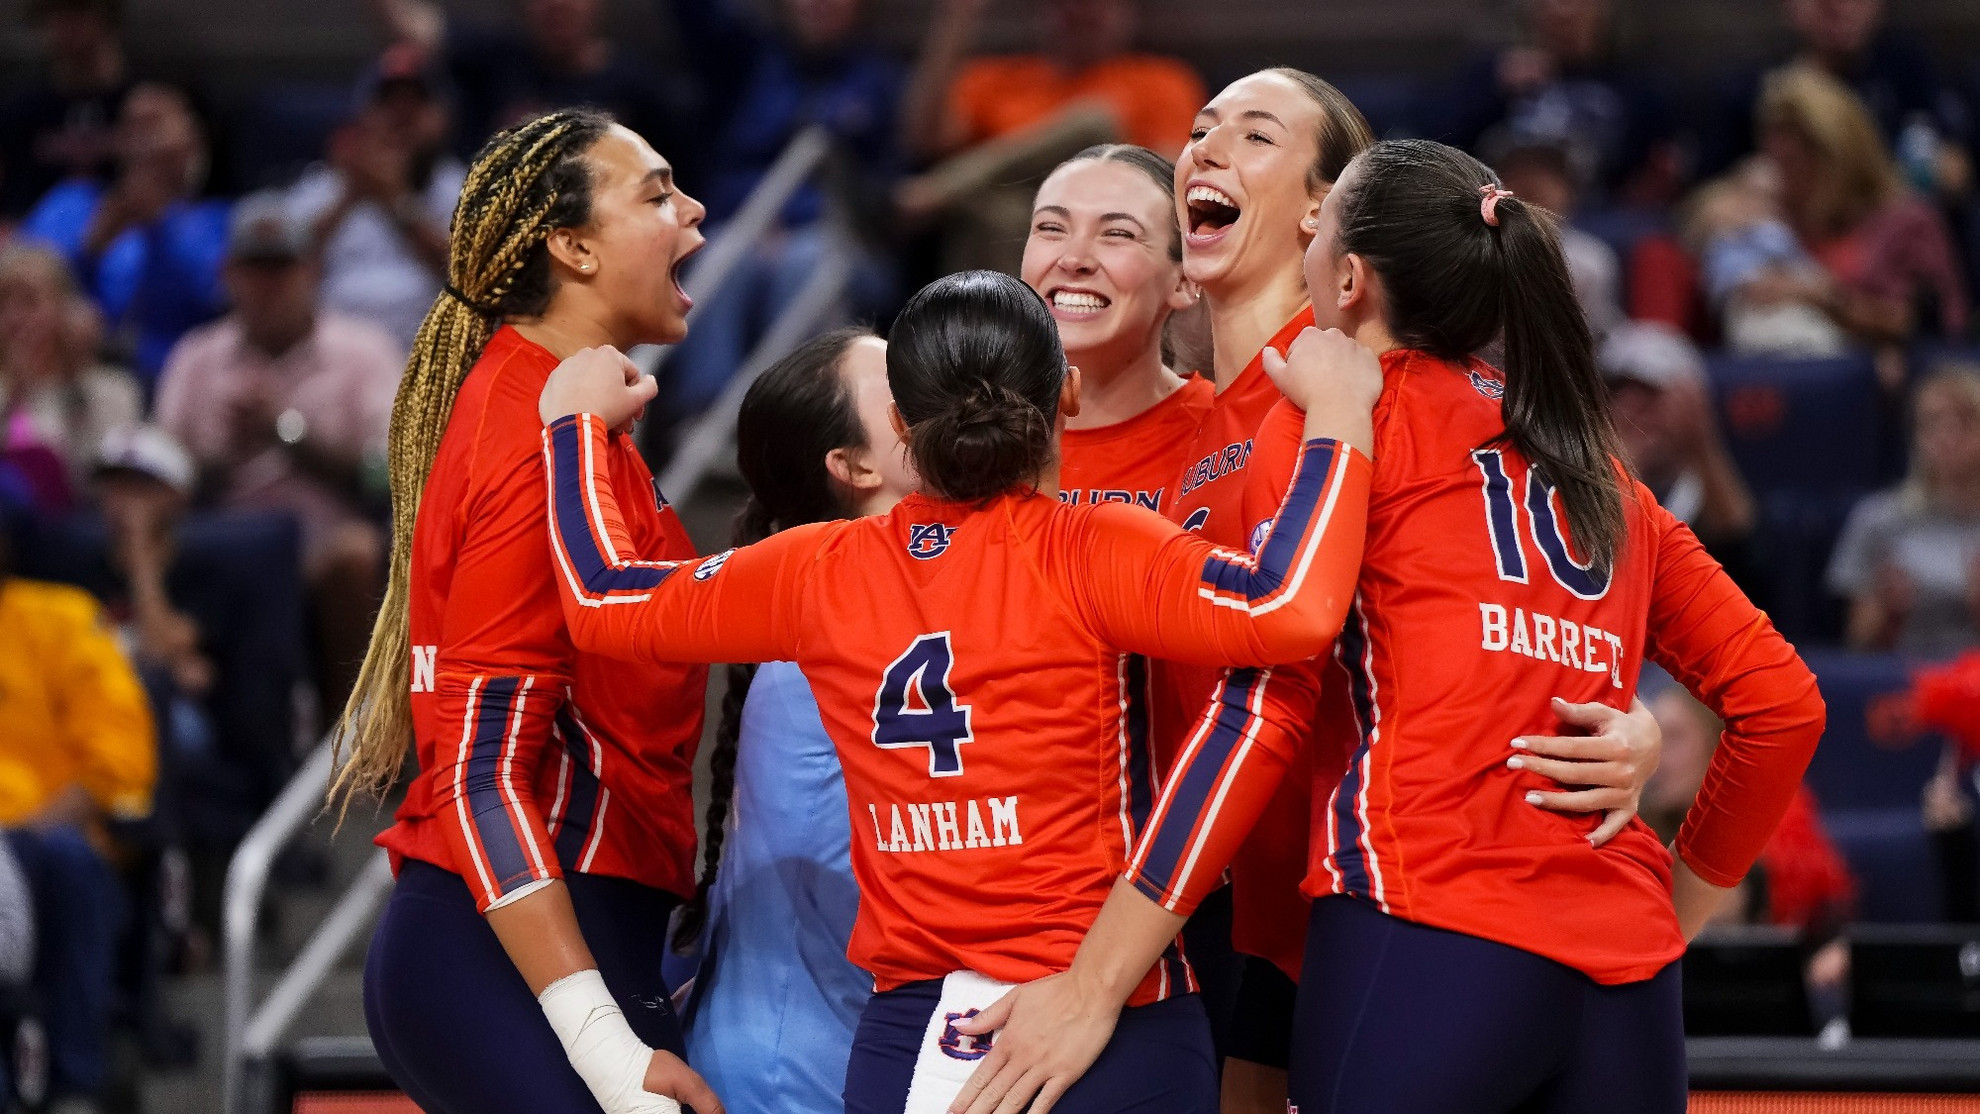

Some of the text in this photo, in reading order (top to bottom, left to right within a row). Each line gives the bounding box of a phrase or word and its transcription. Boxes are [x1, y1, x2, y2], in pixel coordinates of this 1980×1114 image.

[1471, 449, 1614, 600] 10
[871, 630, 974, 778] 4
[868, 796, 1023, 852] LANHAM
